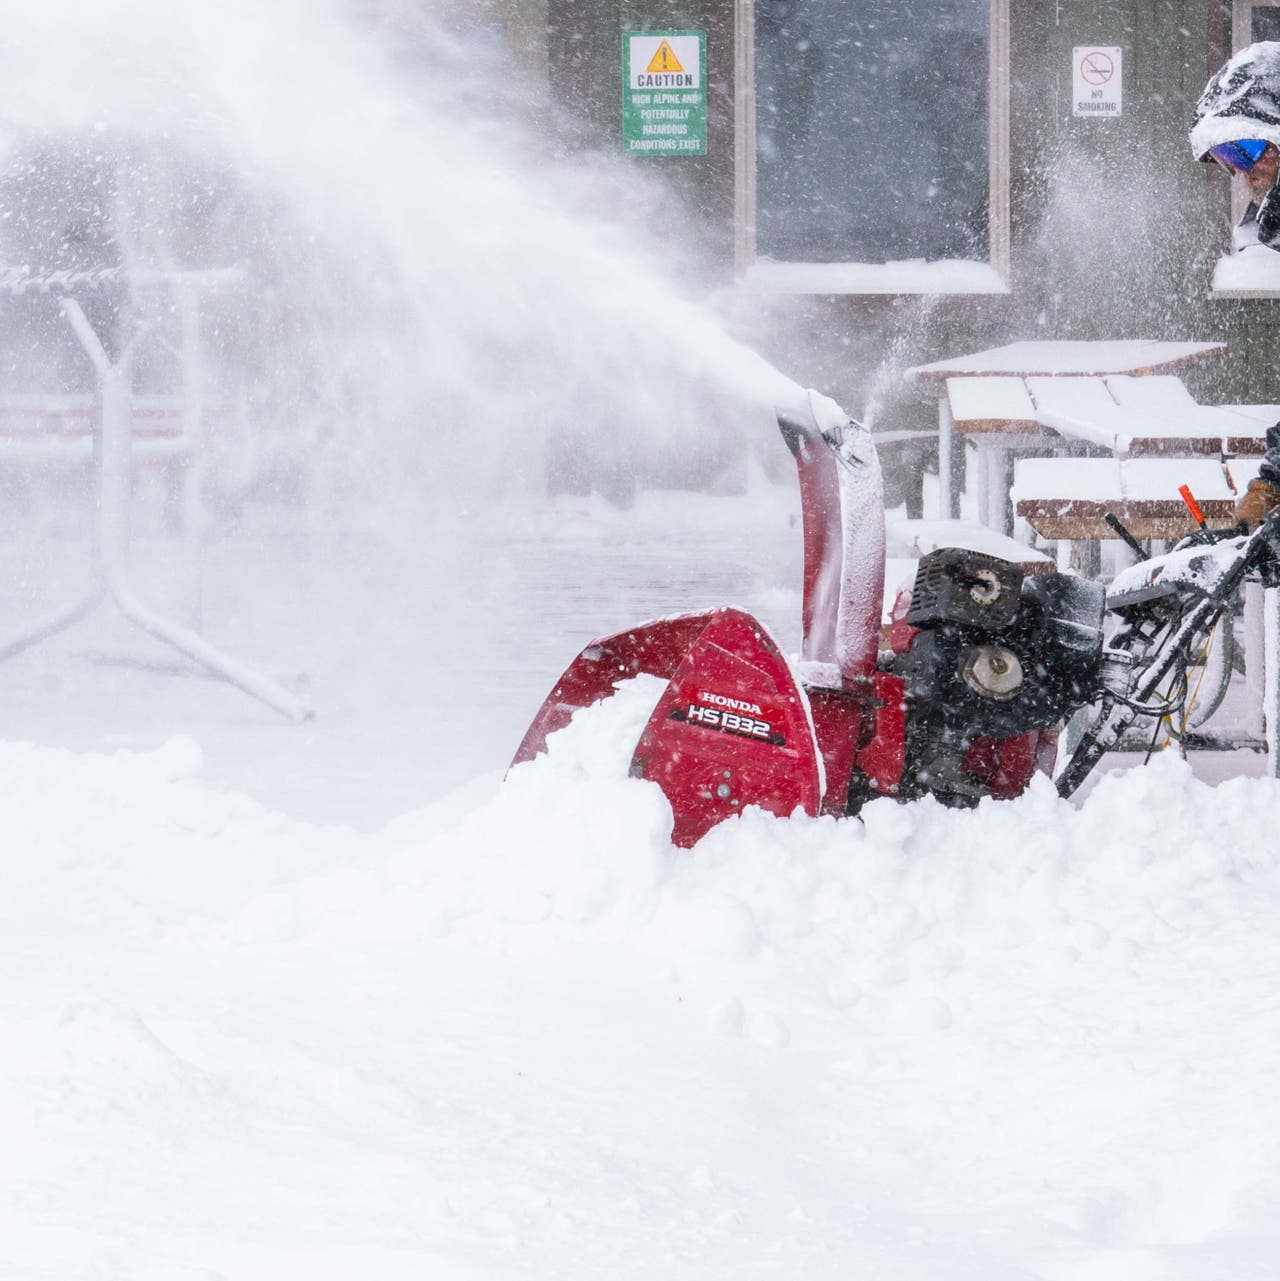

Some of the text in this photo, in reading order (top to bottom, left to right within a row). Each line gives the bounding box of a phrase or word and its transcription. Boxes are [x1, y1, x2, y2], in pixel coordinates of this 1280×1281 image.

[637, 74, 693, 87] CAUTION
[632, 94, 698, 104] HIGH ALPINE AND
[1091, 89, 1103, 99] NO
[1077, 102, 1117, 111] SMOKING
[640, 109, 689, 119] POTENTIALLY
[642, 124, 688, 135] HAZARDOUS
[630, 139, 700, 150] CONDITIONS EXIST
[702, 692, 763, 715] HONDA
[688, 704, 771, 737] HS1332
